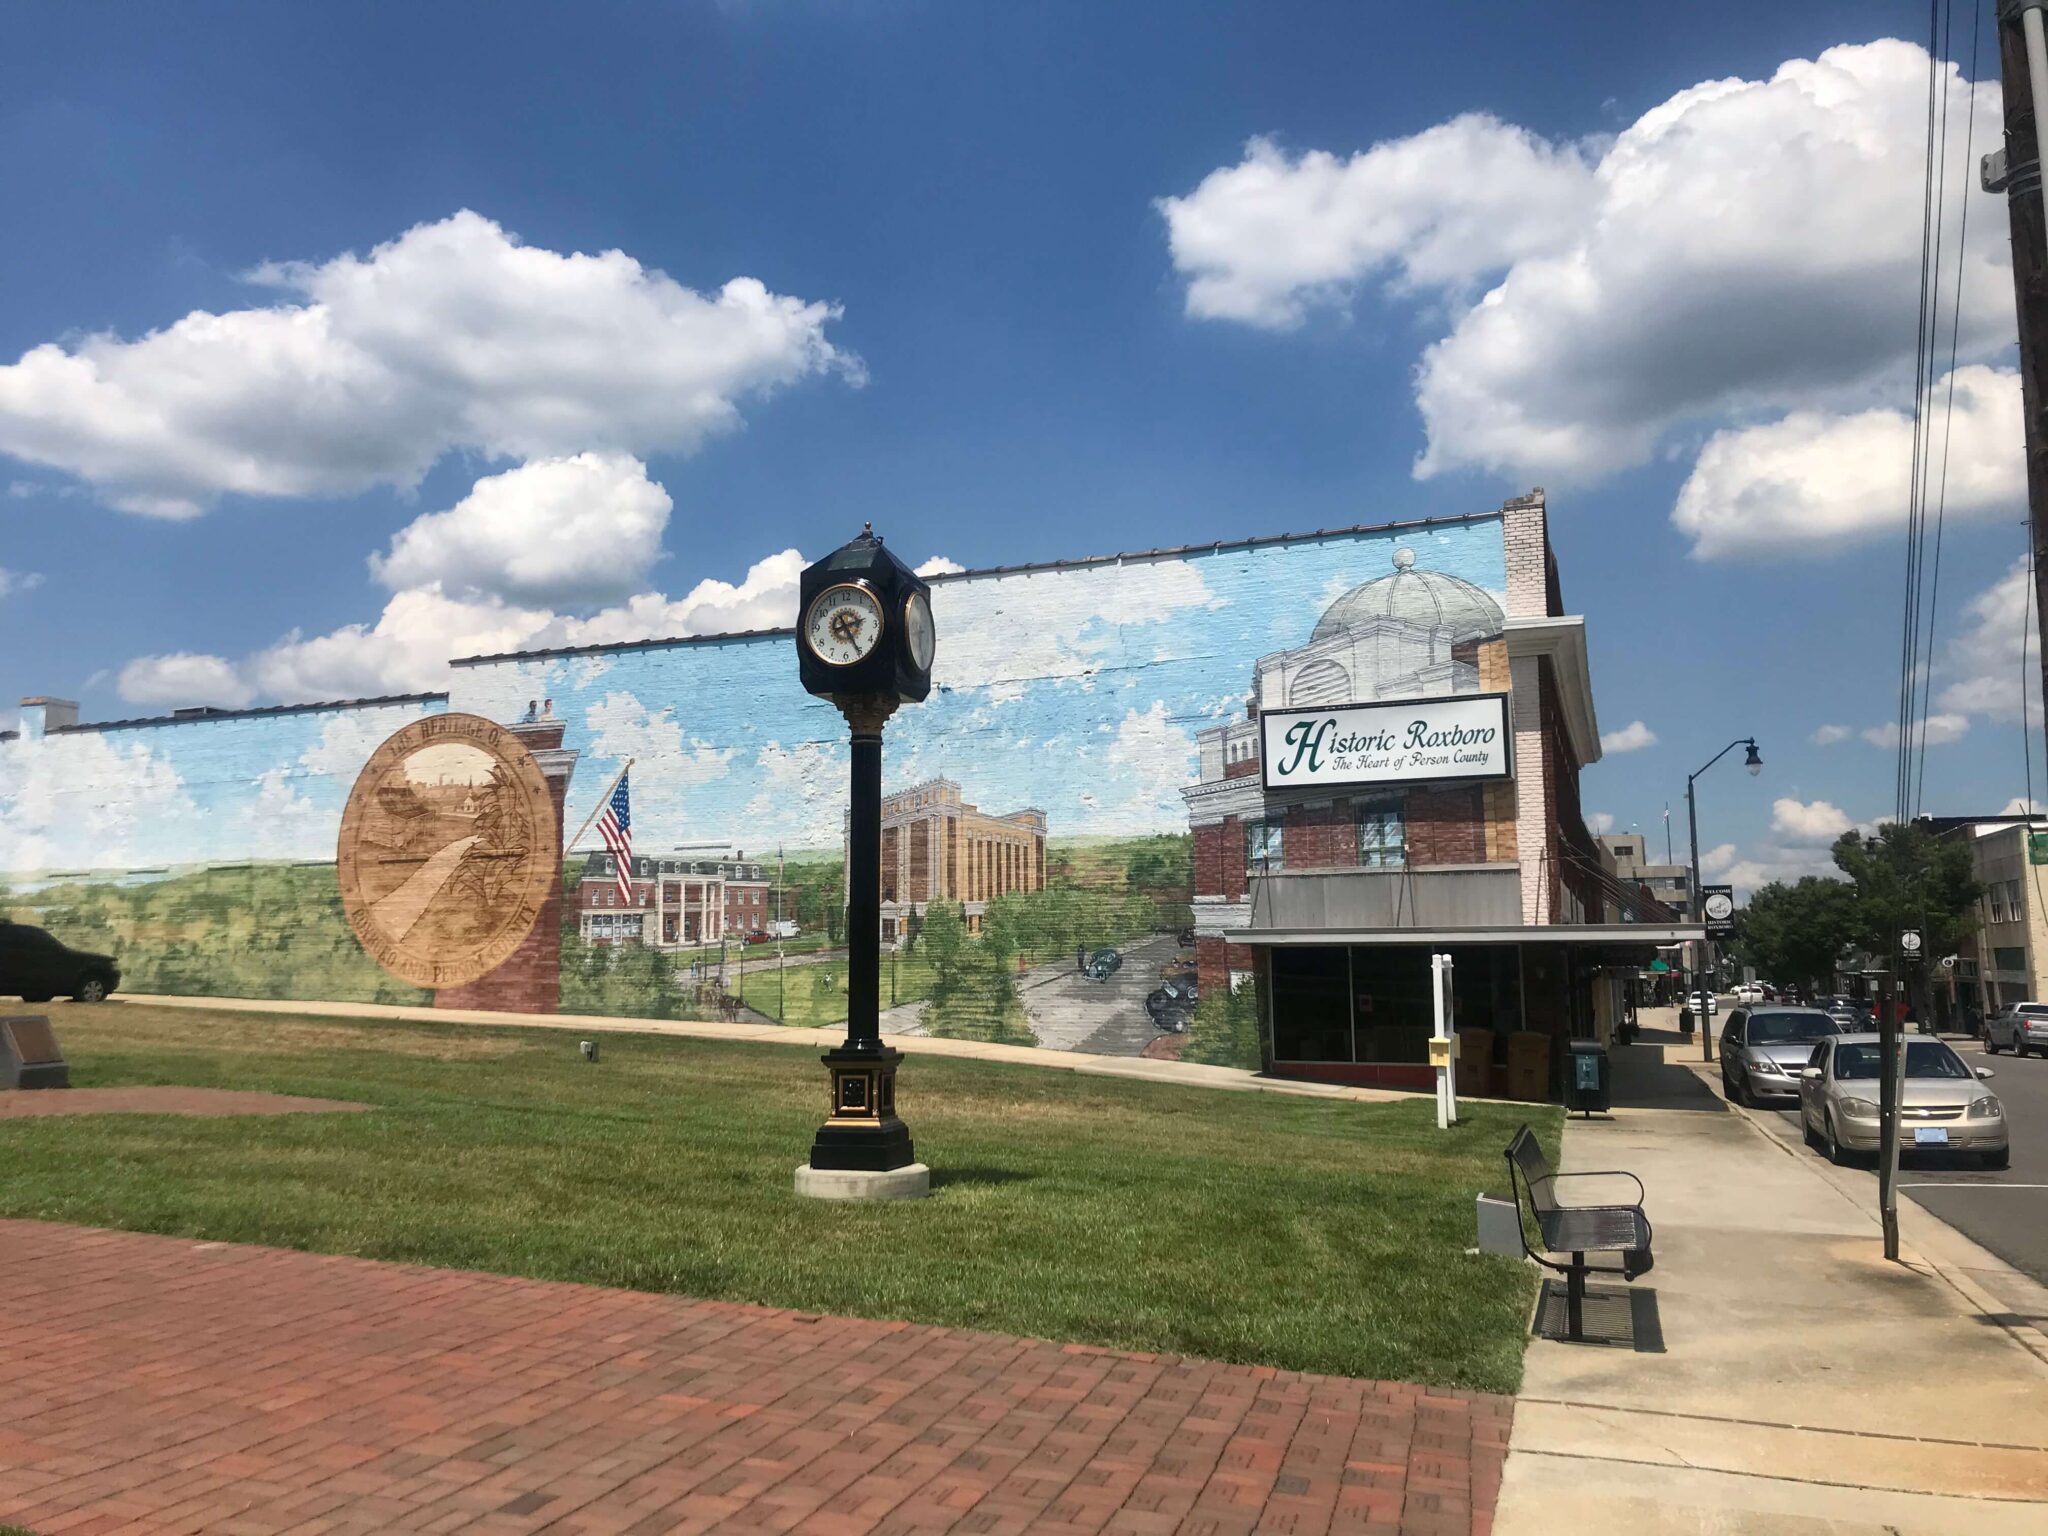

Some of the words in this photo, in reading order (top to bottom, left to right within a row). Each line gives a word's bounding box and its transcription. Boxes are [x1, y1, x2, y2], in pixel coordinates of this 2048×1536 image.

[829, 596, 836, 606] 11
[842, 592, 851, 601] 12
[819, 608, 828, 618] 10
[814, 624, 821, 632] 9
[873, 619, 878, 629] 3
[819, 639, 825, 647] 8
[867, 635, 874, 643] 4
[830, 648, 835, 656] 7
[843, 651, 849, 660] 6
[1278, 718, 1396, 776] Historic
[1403, 719, 1495, 750] Roxboro
[1332, 756, 1353, 771] The
[1356, 754, 1390, 770] Heart
[1393, 754, 1407, 771] of
[1409, 751, 1450, 767] Person
[1453, 748, 1489, 766] County
